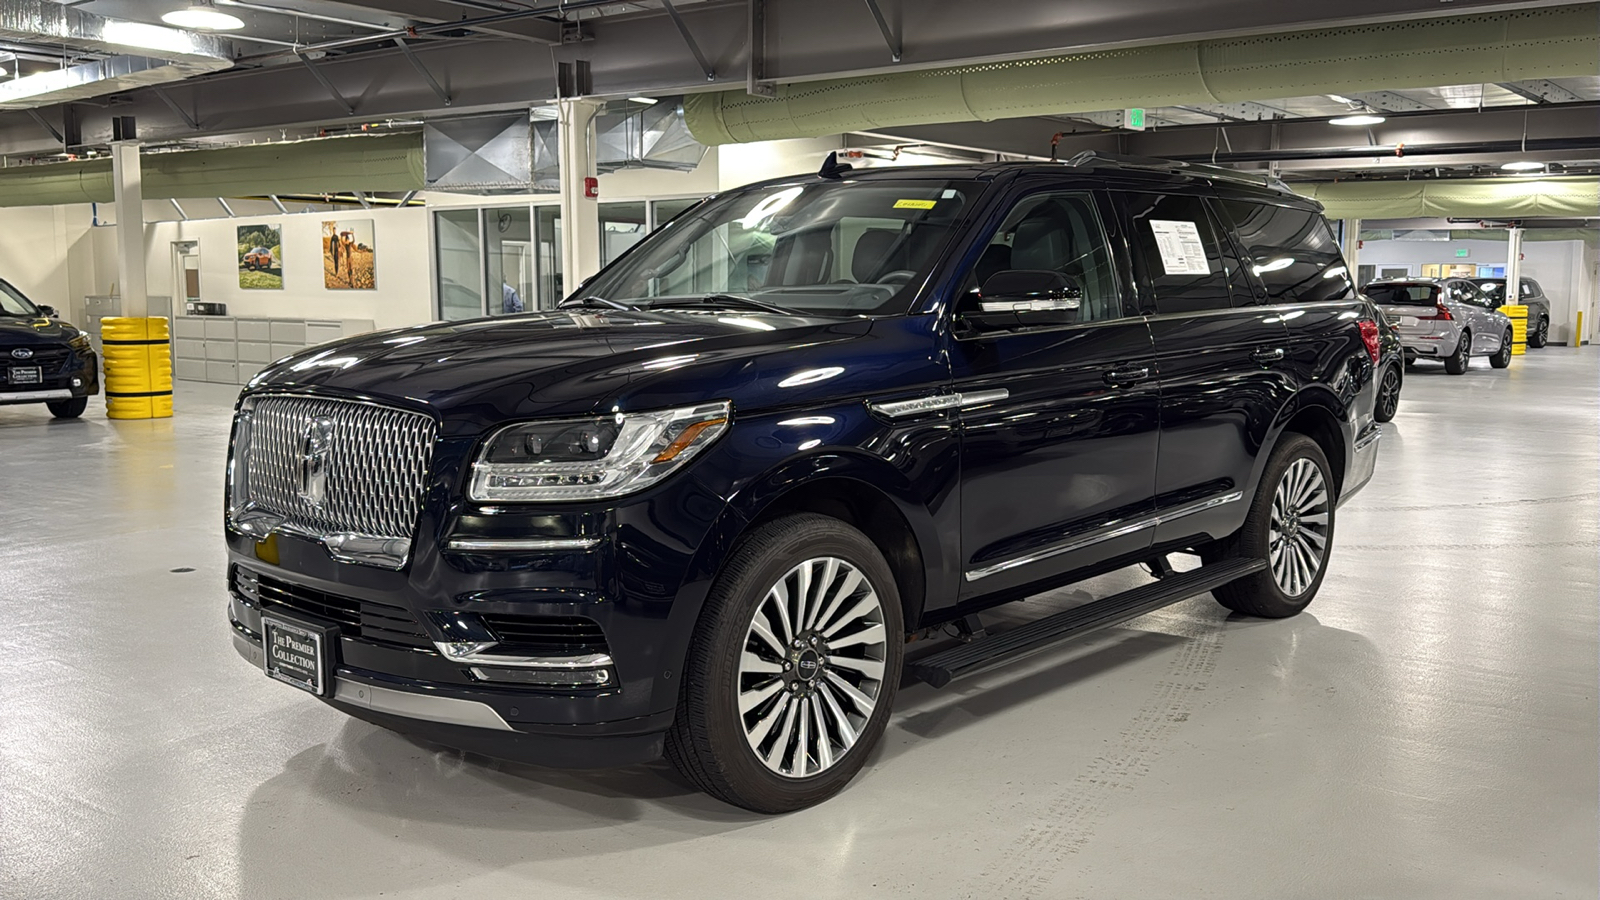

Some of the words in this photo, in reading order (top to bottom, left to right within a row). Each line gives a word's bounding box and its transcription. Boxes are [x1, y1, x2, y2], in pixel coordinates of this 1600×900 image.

[272, 630, 286, 647] THE
[285, 635, 315, 656] PREMIER
[272, 644, 315, 670] COLLECTION
